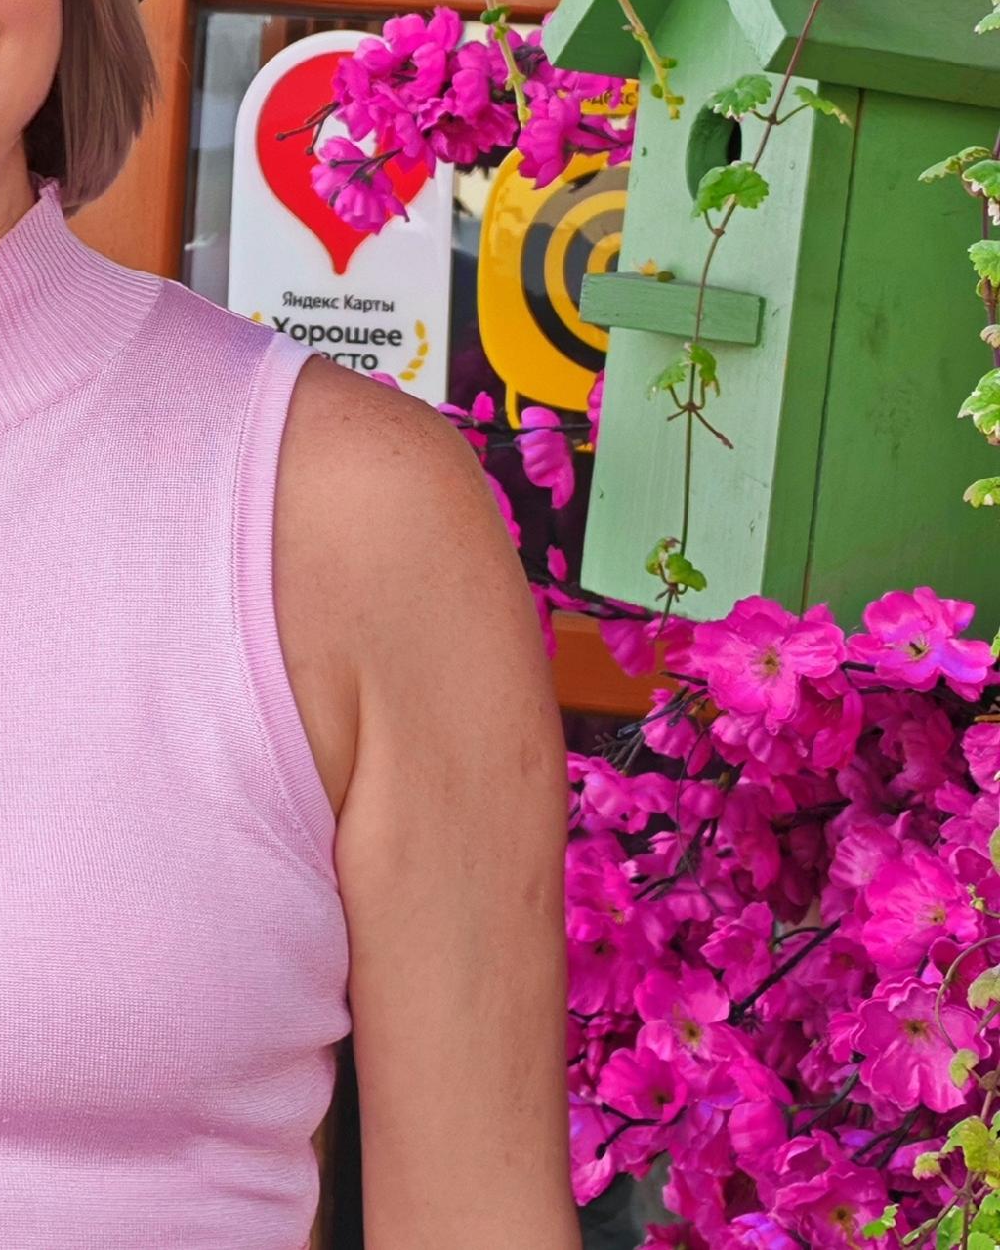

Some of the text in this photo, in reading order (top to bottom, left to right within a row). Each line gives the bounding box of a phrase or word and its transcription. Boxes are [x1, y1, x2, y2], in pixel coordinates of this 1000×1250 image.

[282, 291, 395, 313] Яндекс Карты
[272, 316, 403, 347] Хорошее
[320, 351, 379, 371] сто
